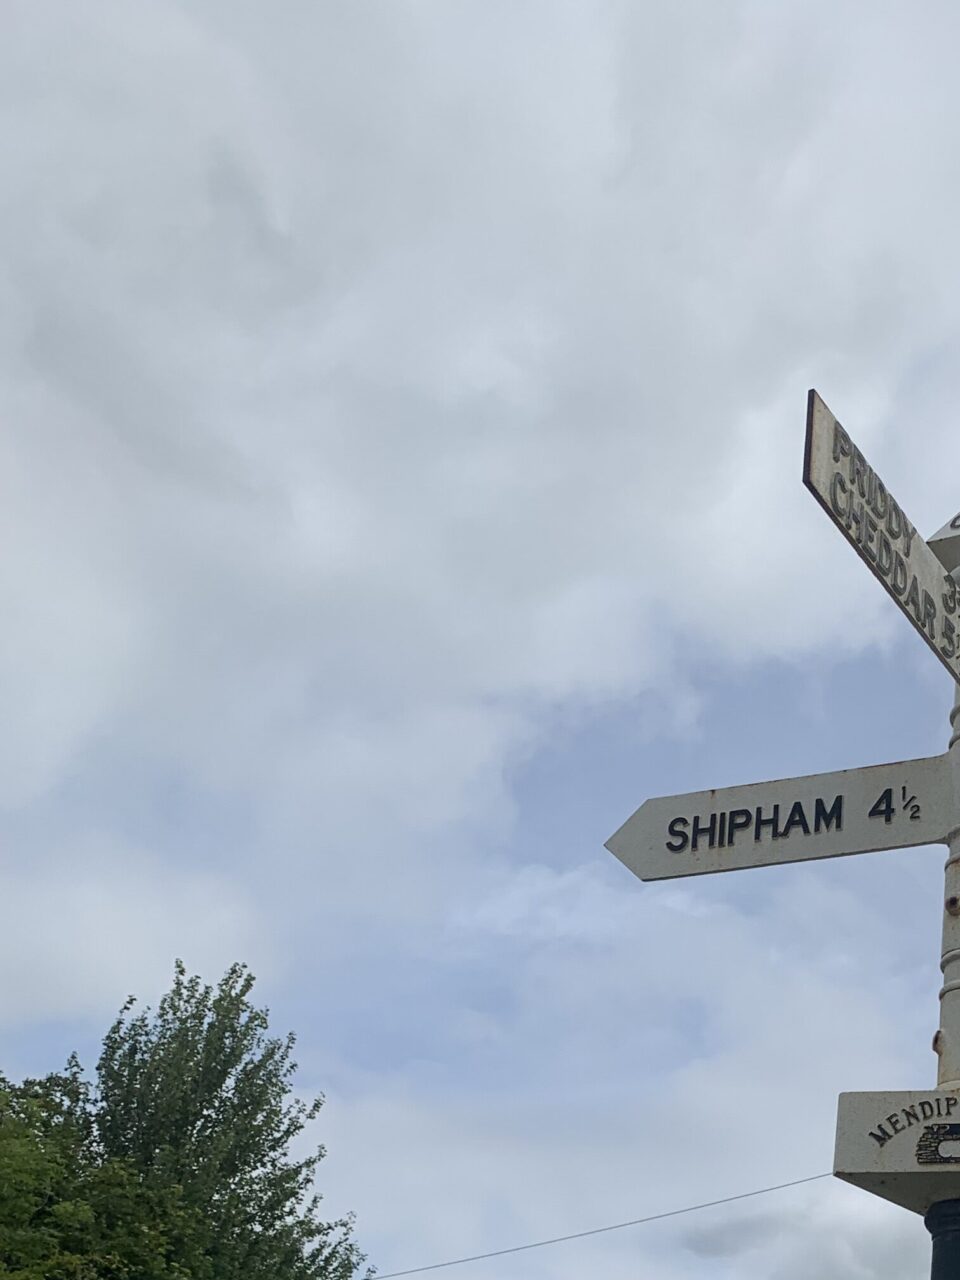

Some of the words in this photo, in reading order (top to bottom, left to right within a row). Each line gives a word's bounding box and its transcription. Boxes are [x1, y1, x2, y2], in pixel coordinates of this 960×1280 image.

[833, 421, 917, 557] PRIDDY
[830, 471, 936, 640] CHEDDAR
[664, 793, 844, 853] SHIPHAM
[868, 1097, 958, 1148] MENDIP
